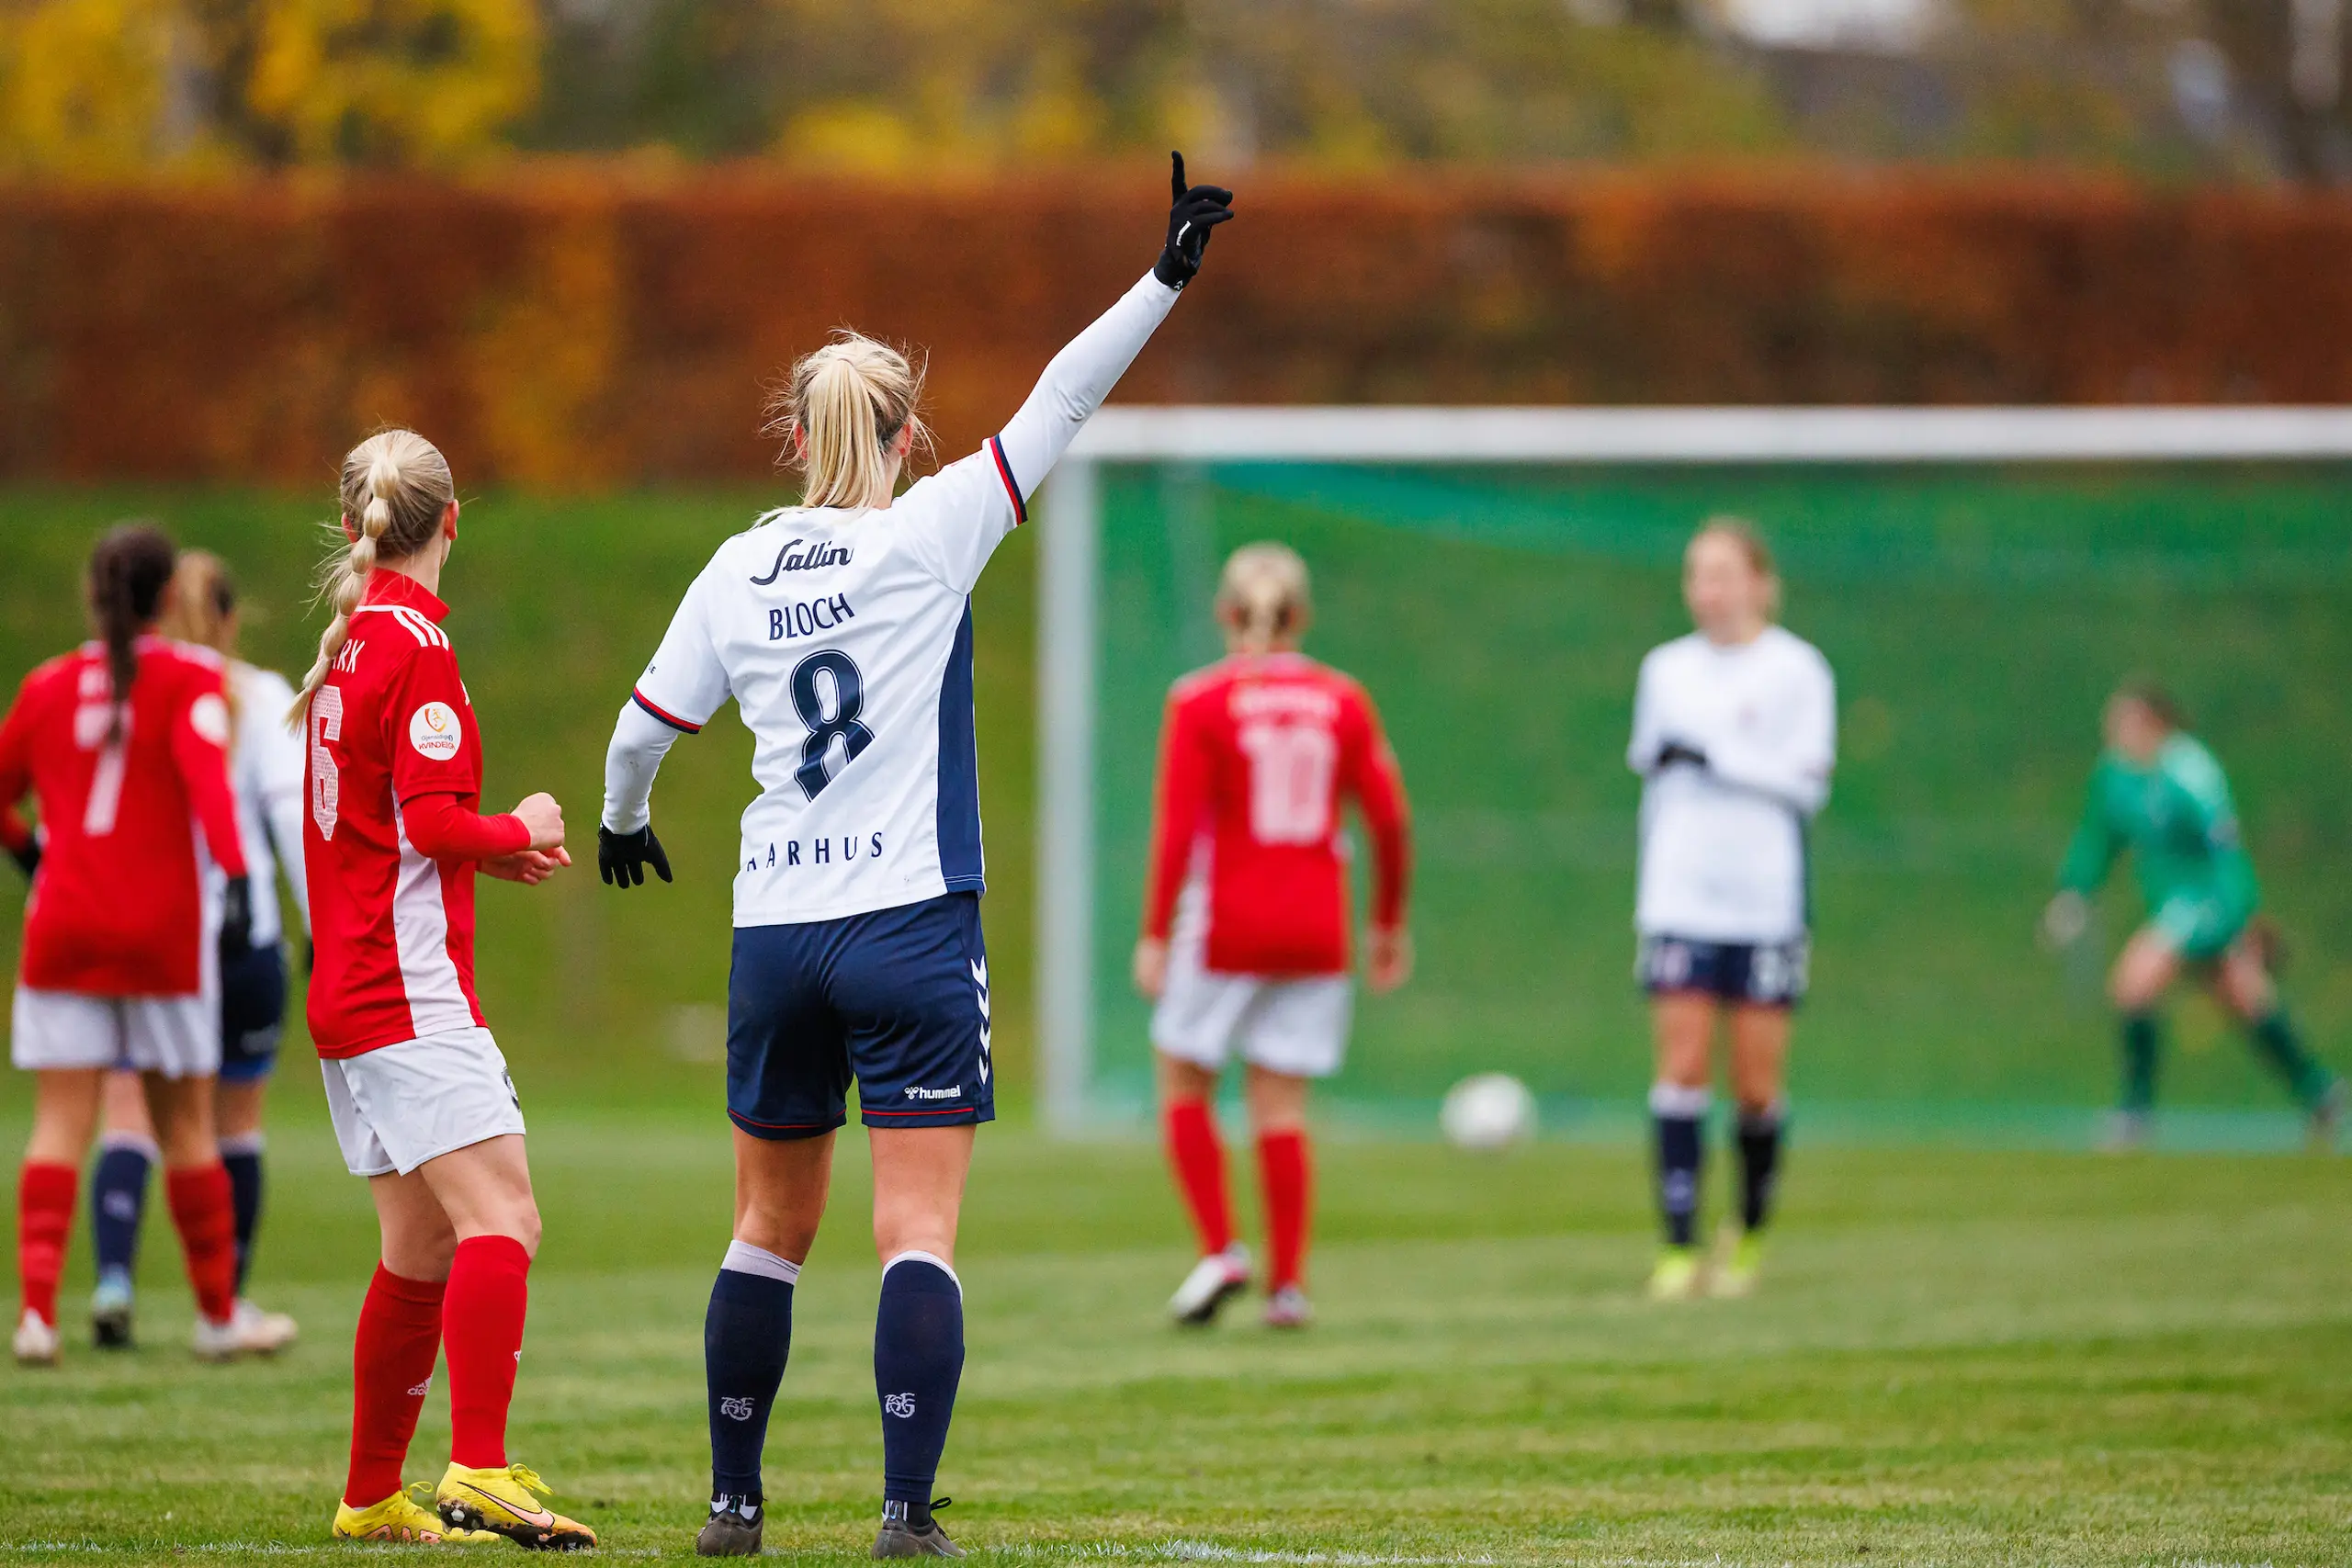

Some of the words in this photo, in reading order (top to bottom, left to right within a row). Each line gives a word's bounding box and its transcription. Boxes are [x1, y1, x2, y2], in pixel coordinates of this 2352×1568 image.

[333, 638, 366, 673] RK
[769, 592, 854, 640] BLOCH
[311, 684, 344, 841] 6
[789, 649, 876, 804] 8
[1236, 725, 1339, 847] 10
[919, 1085, 961, 1099] hummel
